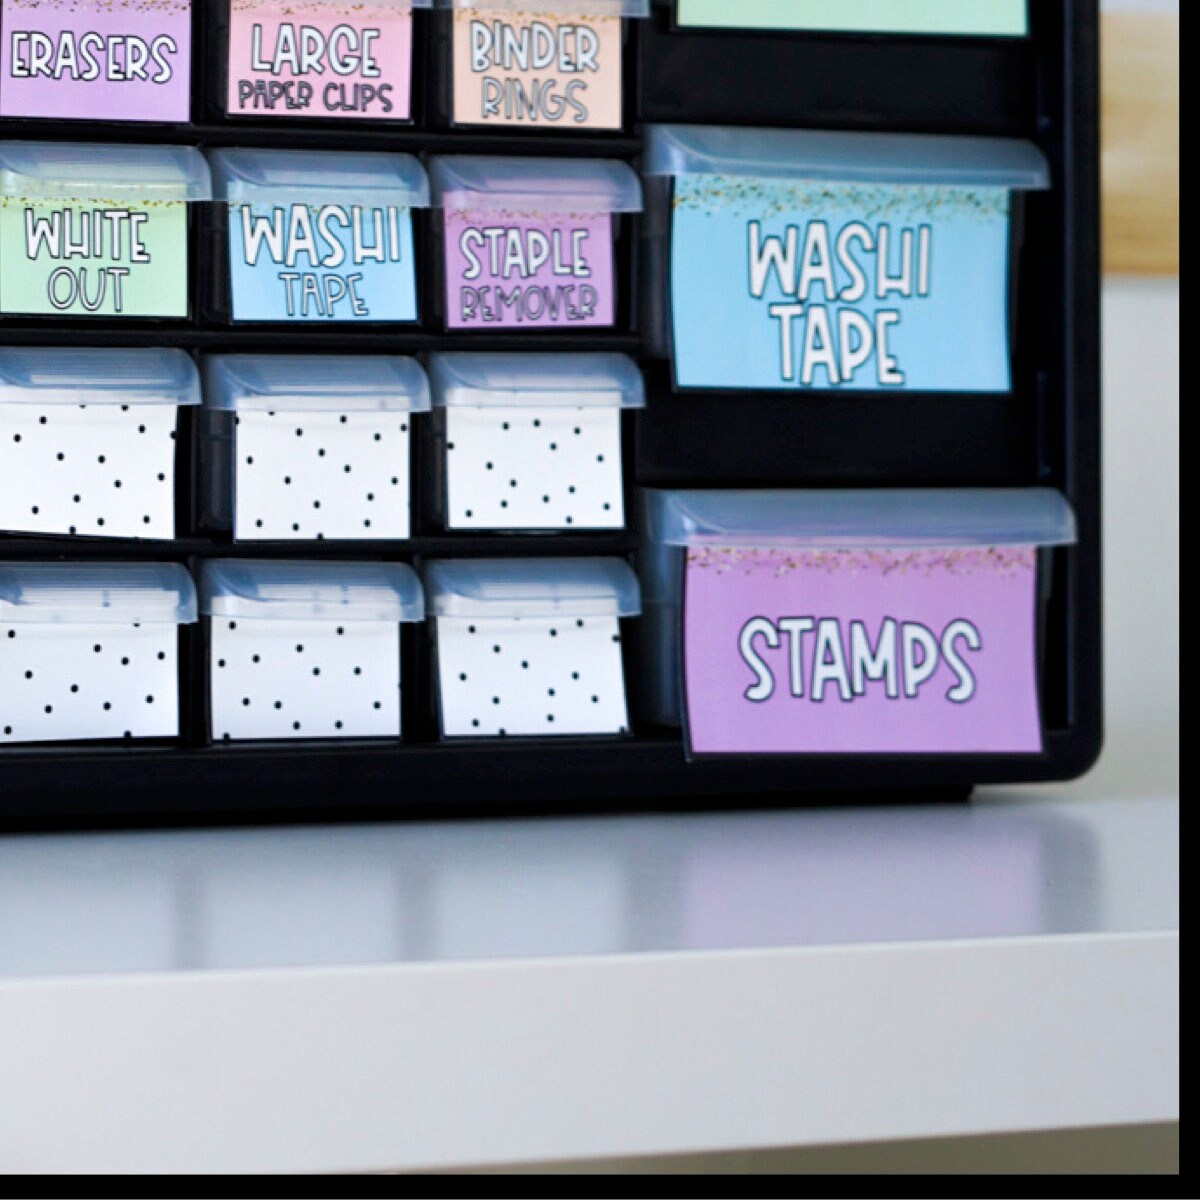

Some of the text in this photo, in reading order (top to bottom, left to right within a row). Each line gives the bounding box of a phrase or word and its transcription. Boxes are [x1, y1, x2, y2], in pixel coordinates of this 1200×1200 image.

[11, 31, 177, 84] ERASERS
[251, 22, 382, 78] LARGE
[469, 20, 600, 74] BINDER
[238, 80, 393, 113] PAPER CLIPS
[482, 77, 589, 122] RINGS
[24, 208, 151, 263] WHITE
[241, 204, 401, 268] WASHI
[459, 226, 592, 281] STAPLE
[747, 220, 932, 302] WASHI
[47, 267, 130, 312] OUT
[278, 272, 369, 317] TAPE
[460, 285, 598, 323] REMOVER
[769, 301, 905, 385] TAPE
[738, 616, 982, 703] STAMPS
